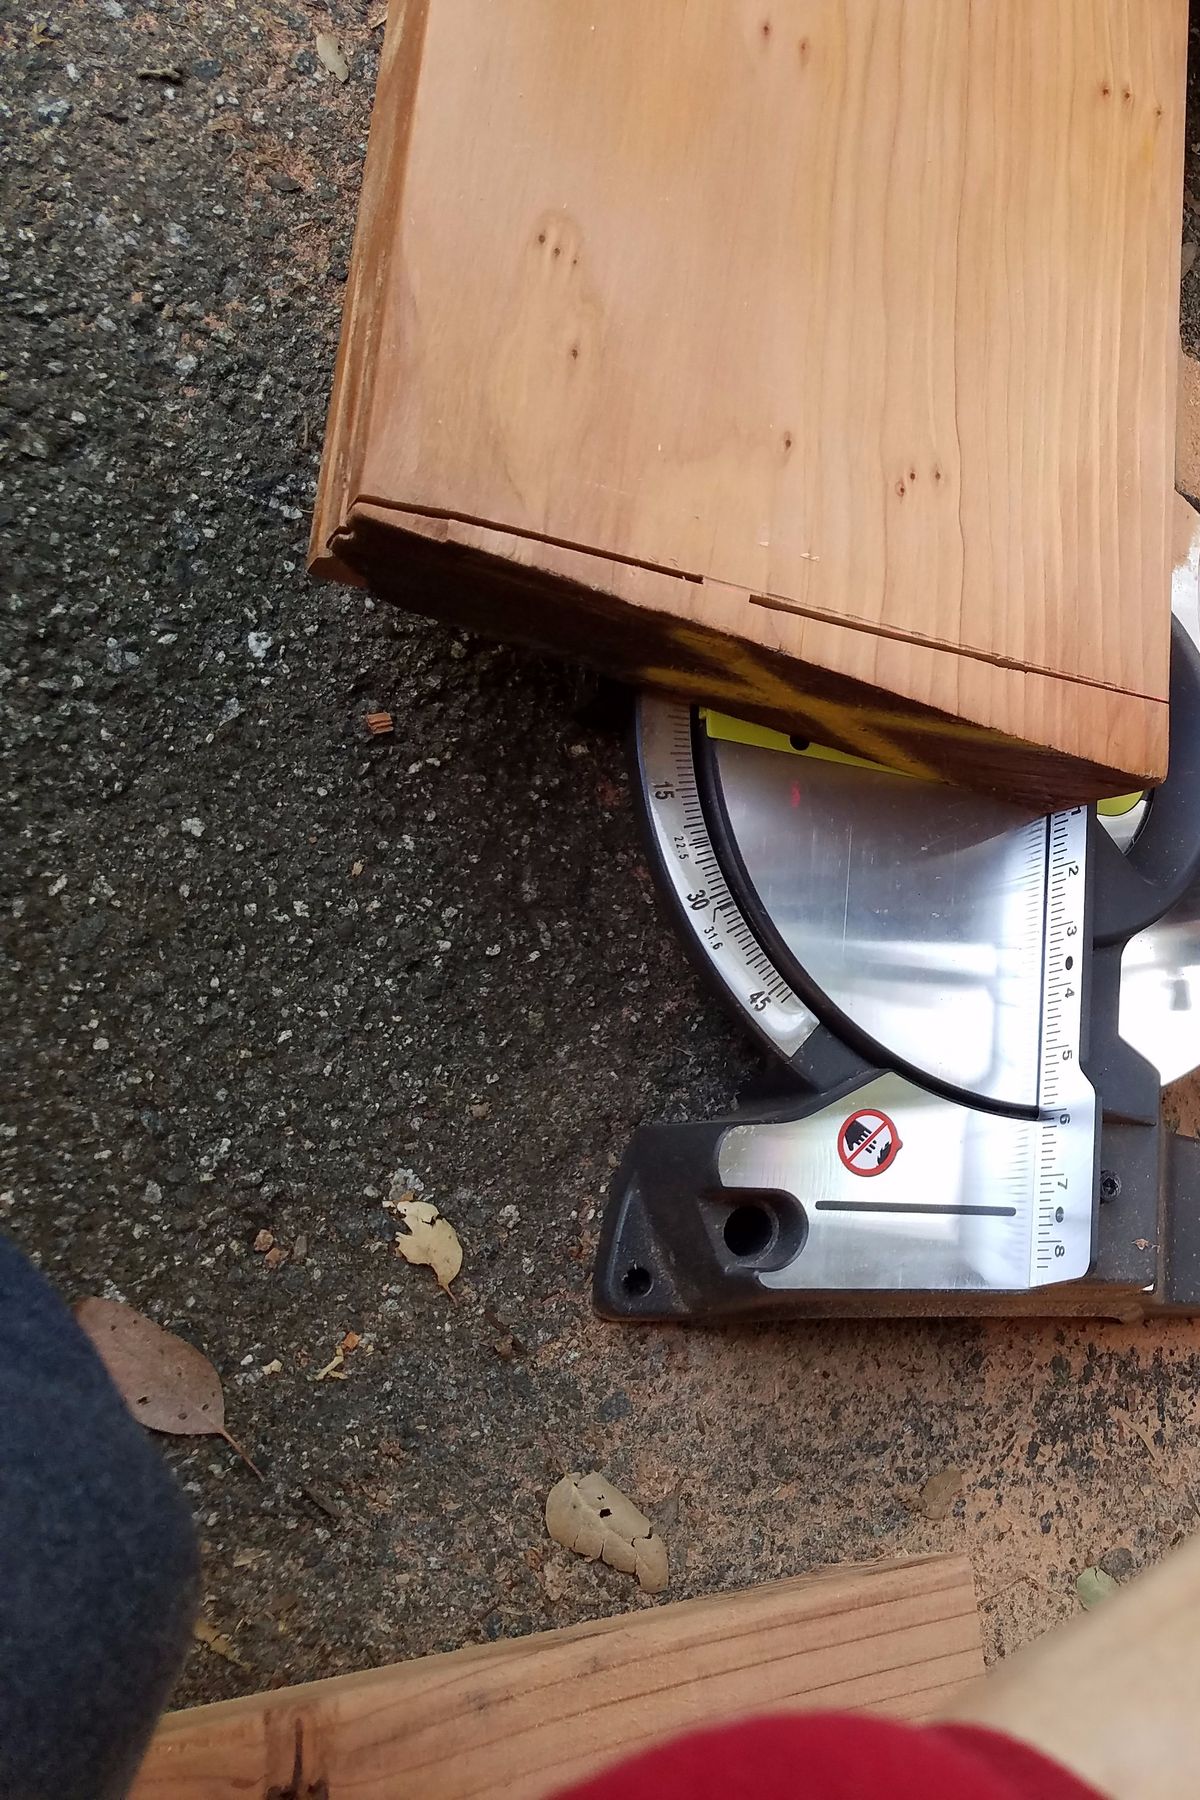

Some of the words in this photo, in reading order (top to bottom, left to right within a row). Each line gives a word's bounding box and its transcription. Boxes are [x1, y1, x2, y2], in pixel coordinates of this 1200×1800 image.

[652, 782, 675, 800] 15
[674, 835, 689, 860] 22.5
[1068, 865, 1079, 877] 2
[686, 888, 710, 911] 30
[704, 925, 723, 950] 31.6
[1067, 926, 1078, 937] 3
[1065, 988, 1075, 998] 4
[748, 989, 771, 1012] 45
[1062, 1050, 1072, 1060] 5
[1059, 1114, 1070, 1126] 6
[1058, 1178, 1068, 1190] 7
[1054, 1245, 1065, 1257] 8
